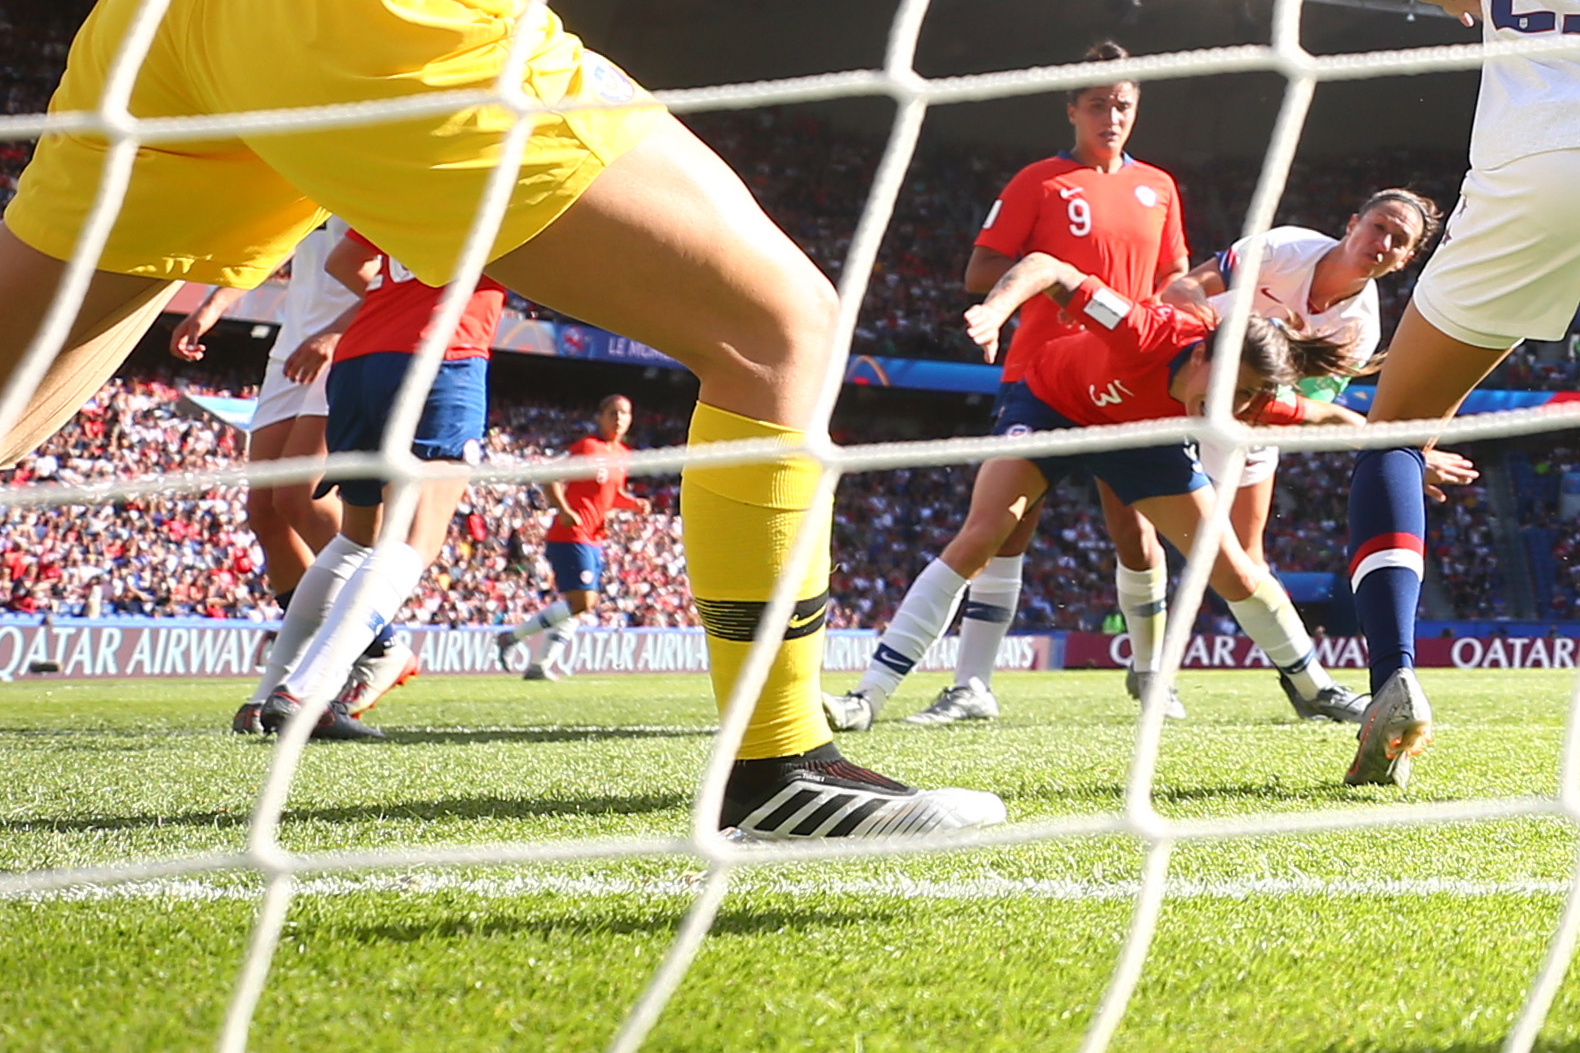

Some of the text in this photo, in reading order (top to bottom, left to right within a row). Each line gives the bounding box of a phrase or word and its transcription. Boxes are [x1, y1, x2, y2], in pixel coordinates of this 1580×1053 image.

[1067, 199, 1093, 238] 9
[0, 626, 270, 682] QATAR AIRWAY
[418, 629, 531, 673] AIRWAS
[1451, 637, 1576, 669] QATAR
